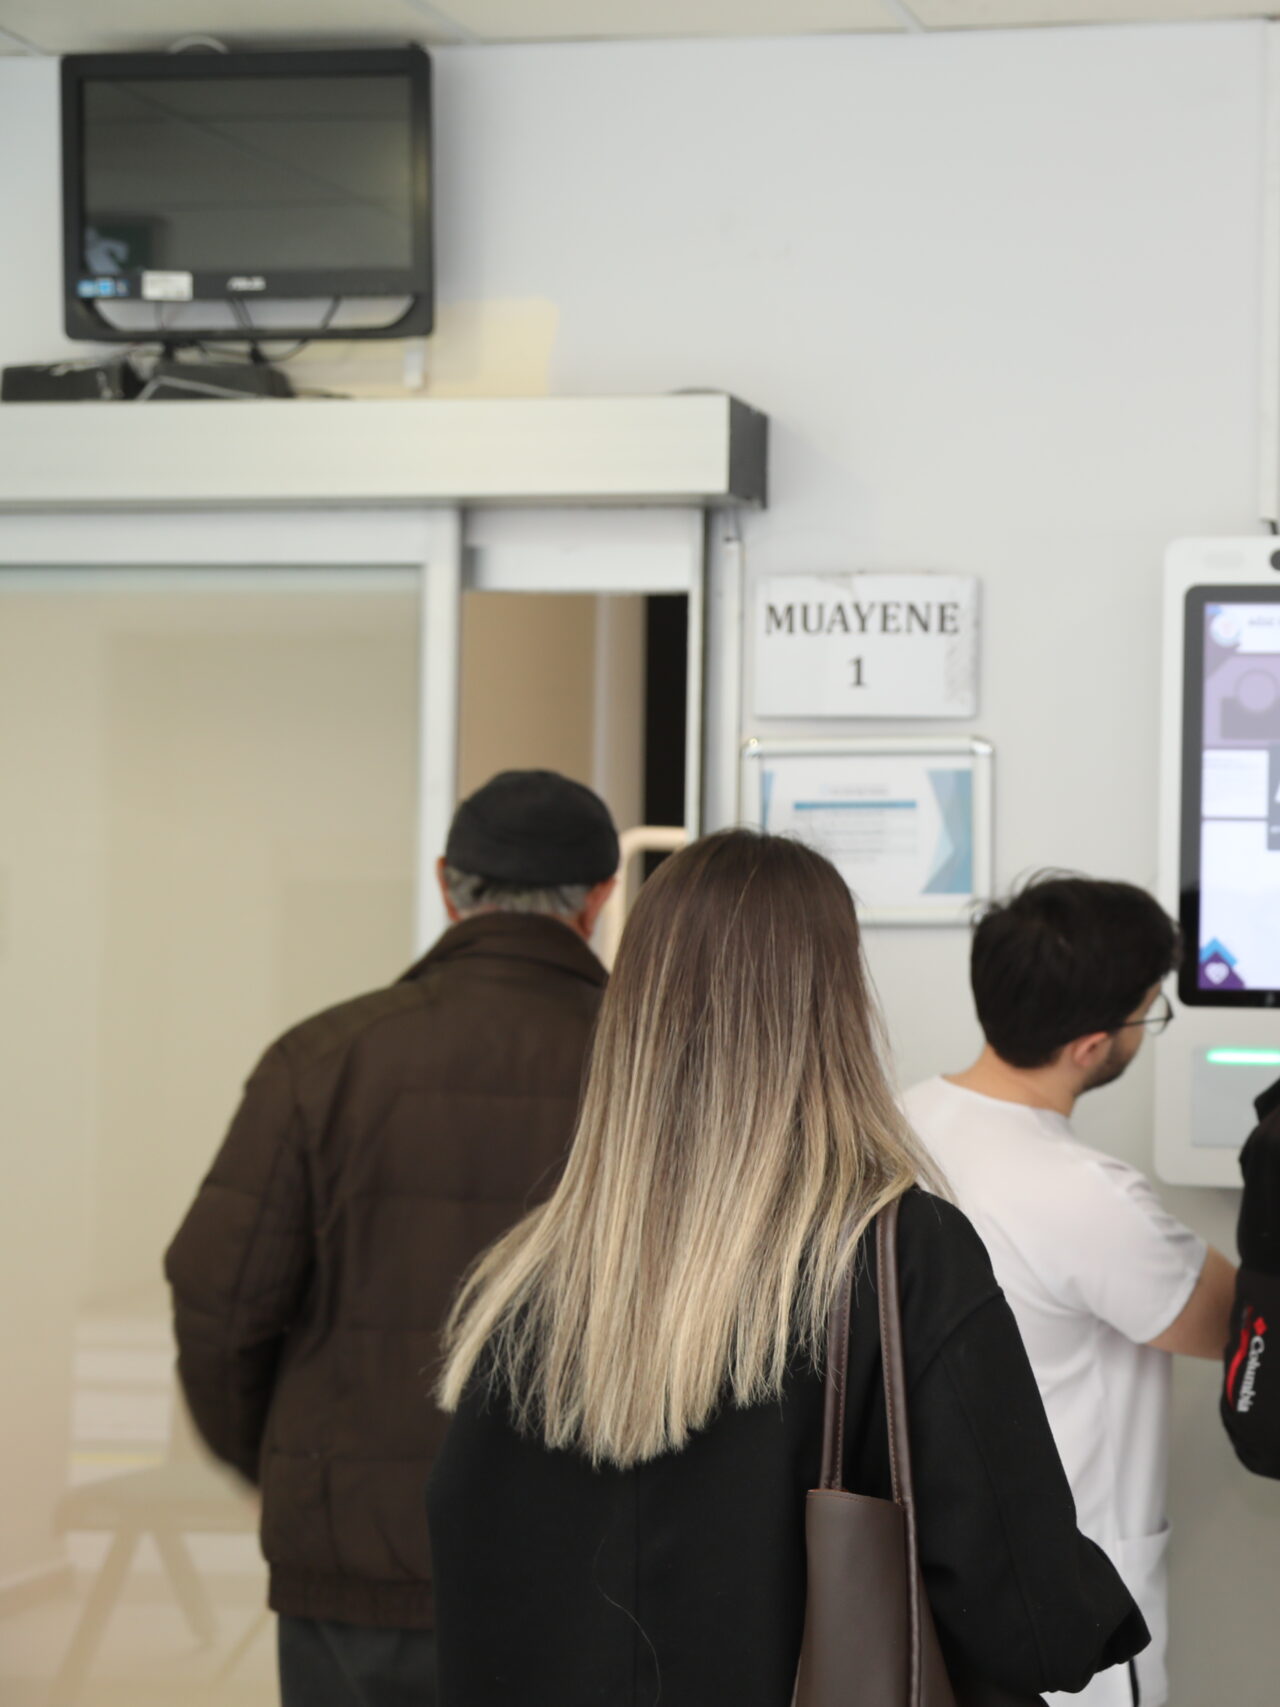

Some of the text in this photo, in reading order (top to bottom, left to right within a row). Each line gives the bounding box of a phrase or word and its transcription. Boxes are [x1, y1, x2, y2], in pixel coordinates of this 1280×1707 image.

[765, 601, 960, 635] MUAYENE
[848, 655, 867, 688] 1
[1237, 1335, 1266, 1412] Columbia
